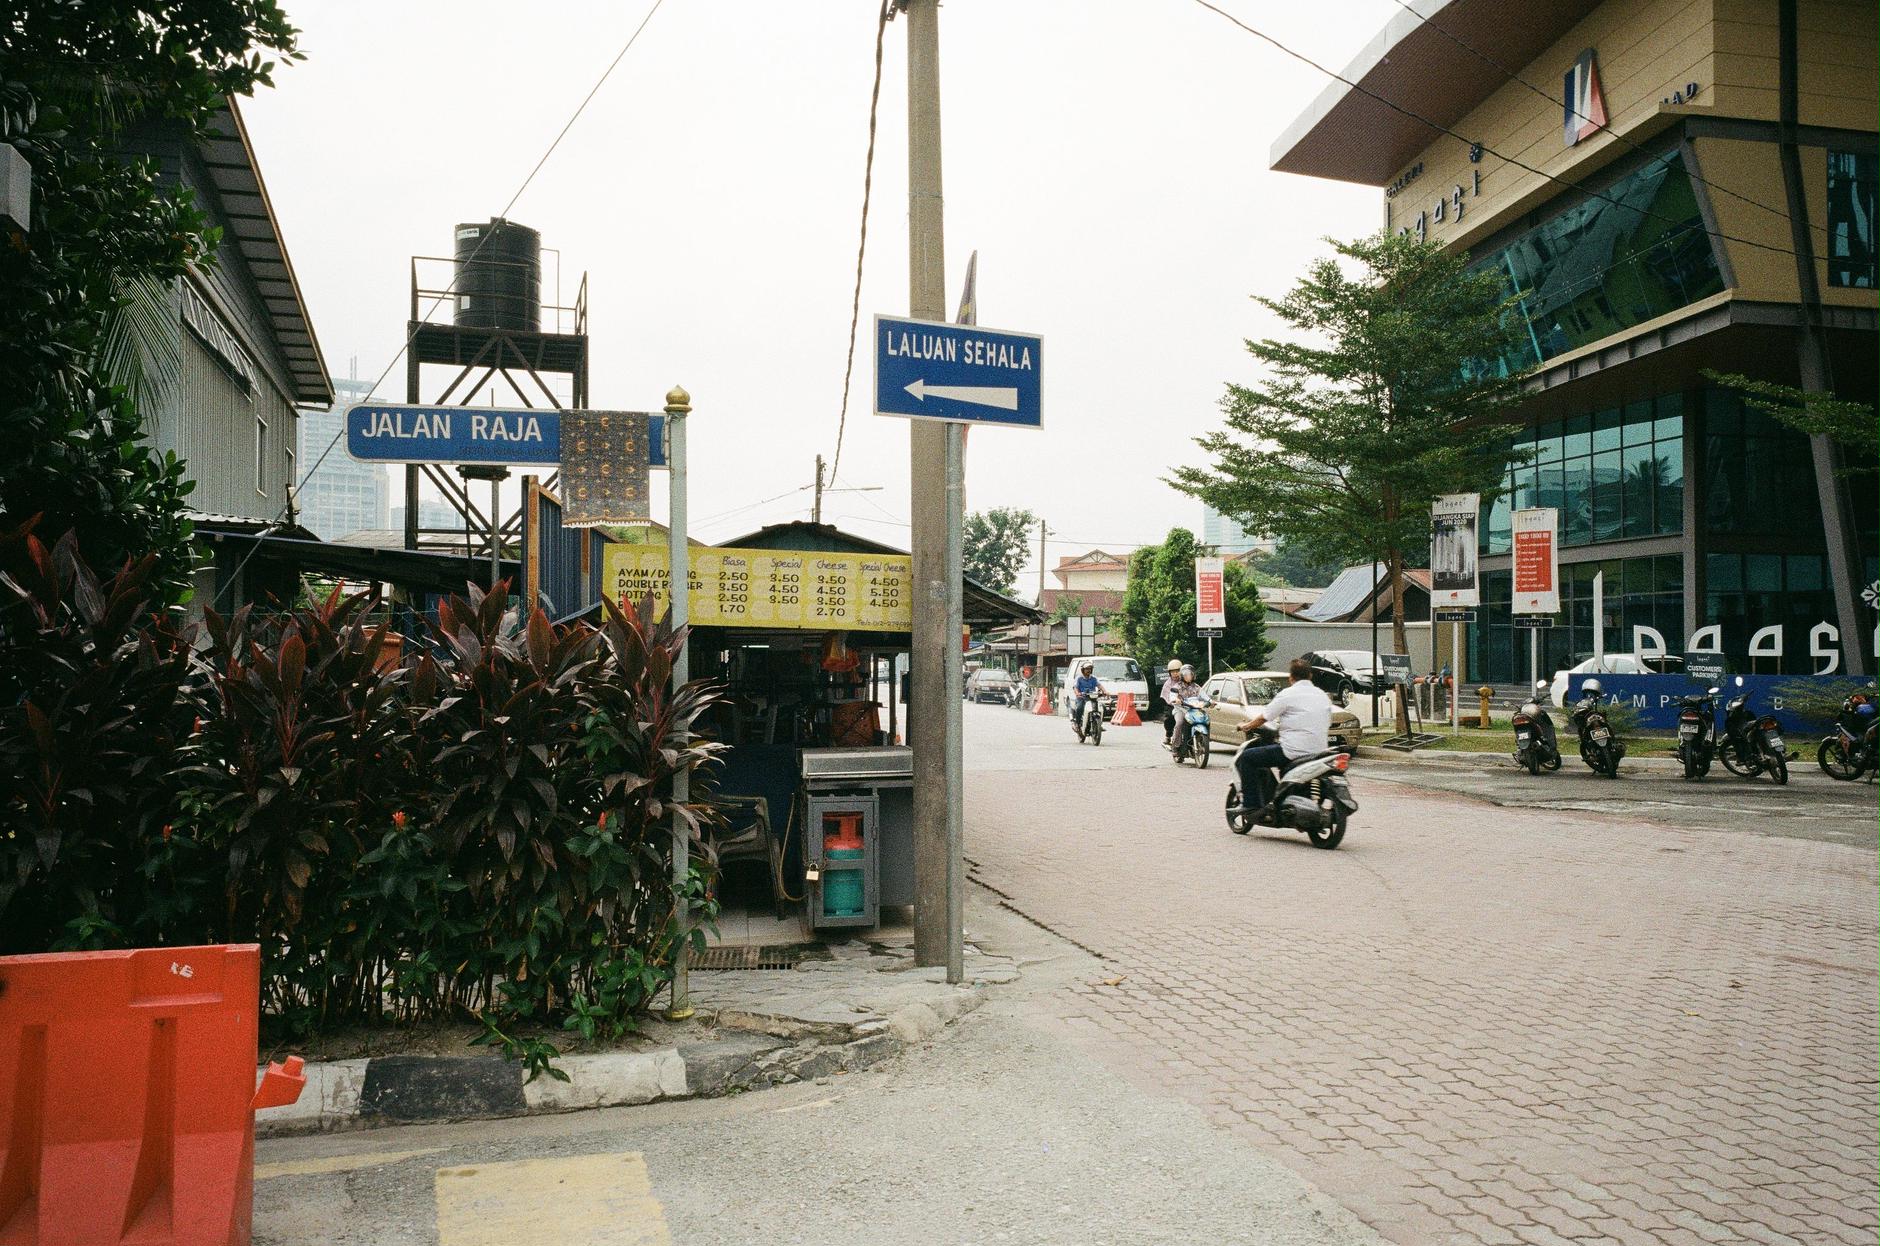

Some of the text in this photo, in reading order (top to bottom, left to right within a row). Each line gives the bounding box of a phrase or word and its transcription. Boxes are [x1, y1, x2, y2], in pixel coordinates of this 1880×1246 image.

[887, 330, 1032, 370] LALUAN SEHALA
[362, 412, 543, 442] JALAN RAJA
[722, 555, 907, 575] Biasa Special Cheese Special Cheese
[719, 571, 749, 581] 2.50
[770, 573, 800, 583] 3.50
[817, 575, 847, 585] 3.50
[870, 577, 899, 587] 4.50
[618, 579, 659, 589] DOUBLE
[718, 582, 748, 592] 3.50
[768, 584, 799, 594] 4.50
[816, 586, 846, 596] 4.50
[870, 588, 899, 598] 5.50
[718, 593, 748, 603] 2.50
[769, 595, 799, 605] 3.50
[816, 596, 846, 606] 3.50
[869, 599, 899, 608] 4.50
[719, 604, 846, 617] 1.70 2.70
[1692, 671, 1718, 679] PARKING
